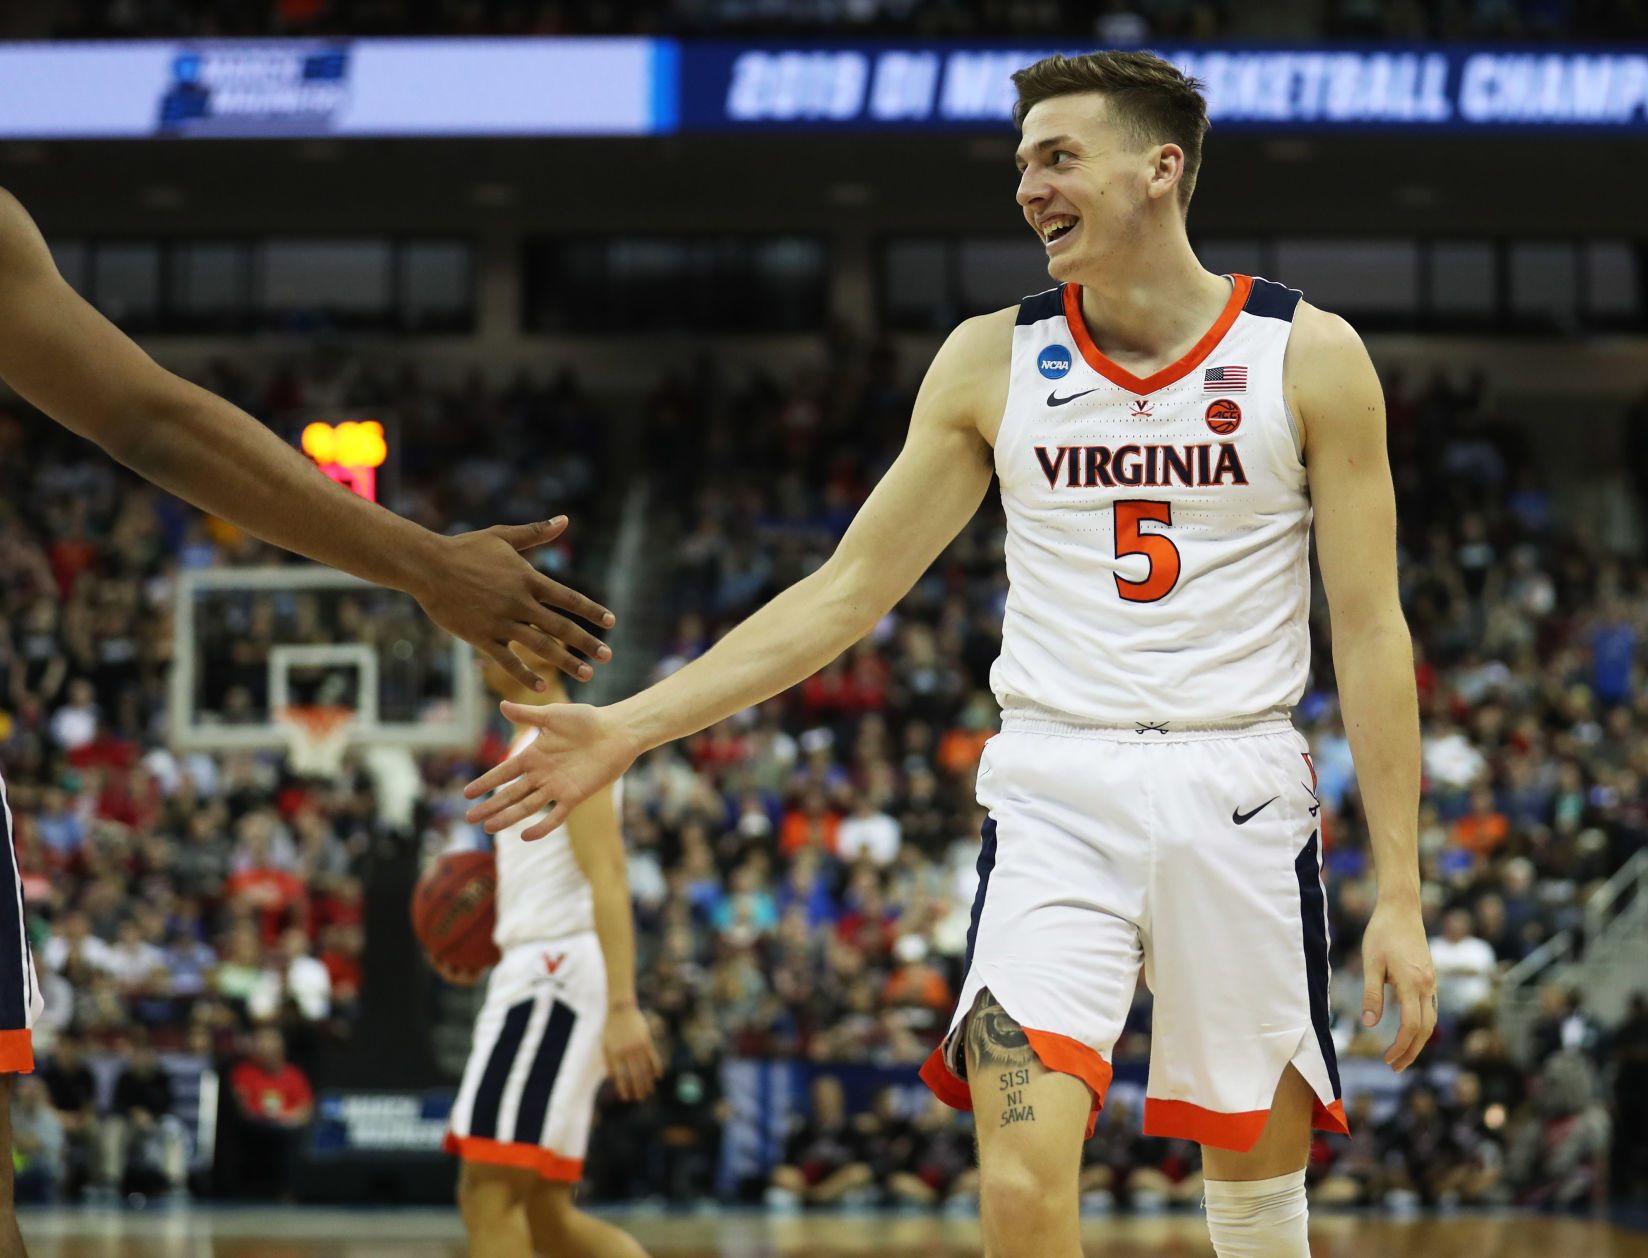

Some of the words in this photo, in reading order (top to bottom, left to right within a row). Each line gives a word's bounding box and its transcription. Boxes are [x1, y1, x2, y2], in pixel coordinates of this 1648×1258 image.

[1170, 51, 1451, 121] SKETBALL
[1459, 53, 1648, 123] CHAMP
[1041, 360, 1069, 370] NCAA
[1211, 410, 1239, 420] ACC
[1034, 443, 1249, 490] VIRGINIA
[1113, 499, 1181, 603] 5
[1000, 1069, 1030, 1091] SISI
[1007, 1090, 1023, 1107] NI
[1000, 1105, 1035, 1128] SAWA
